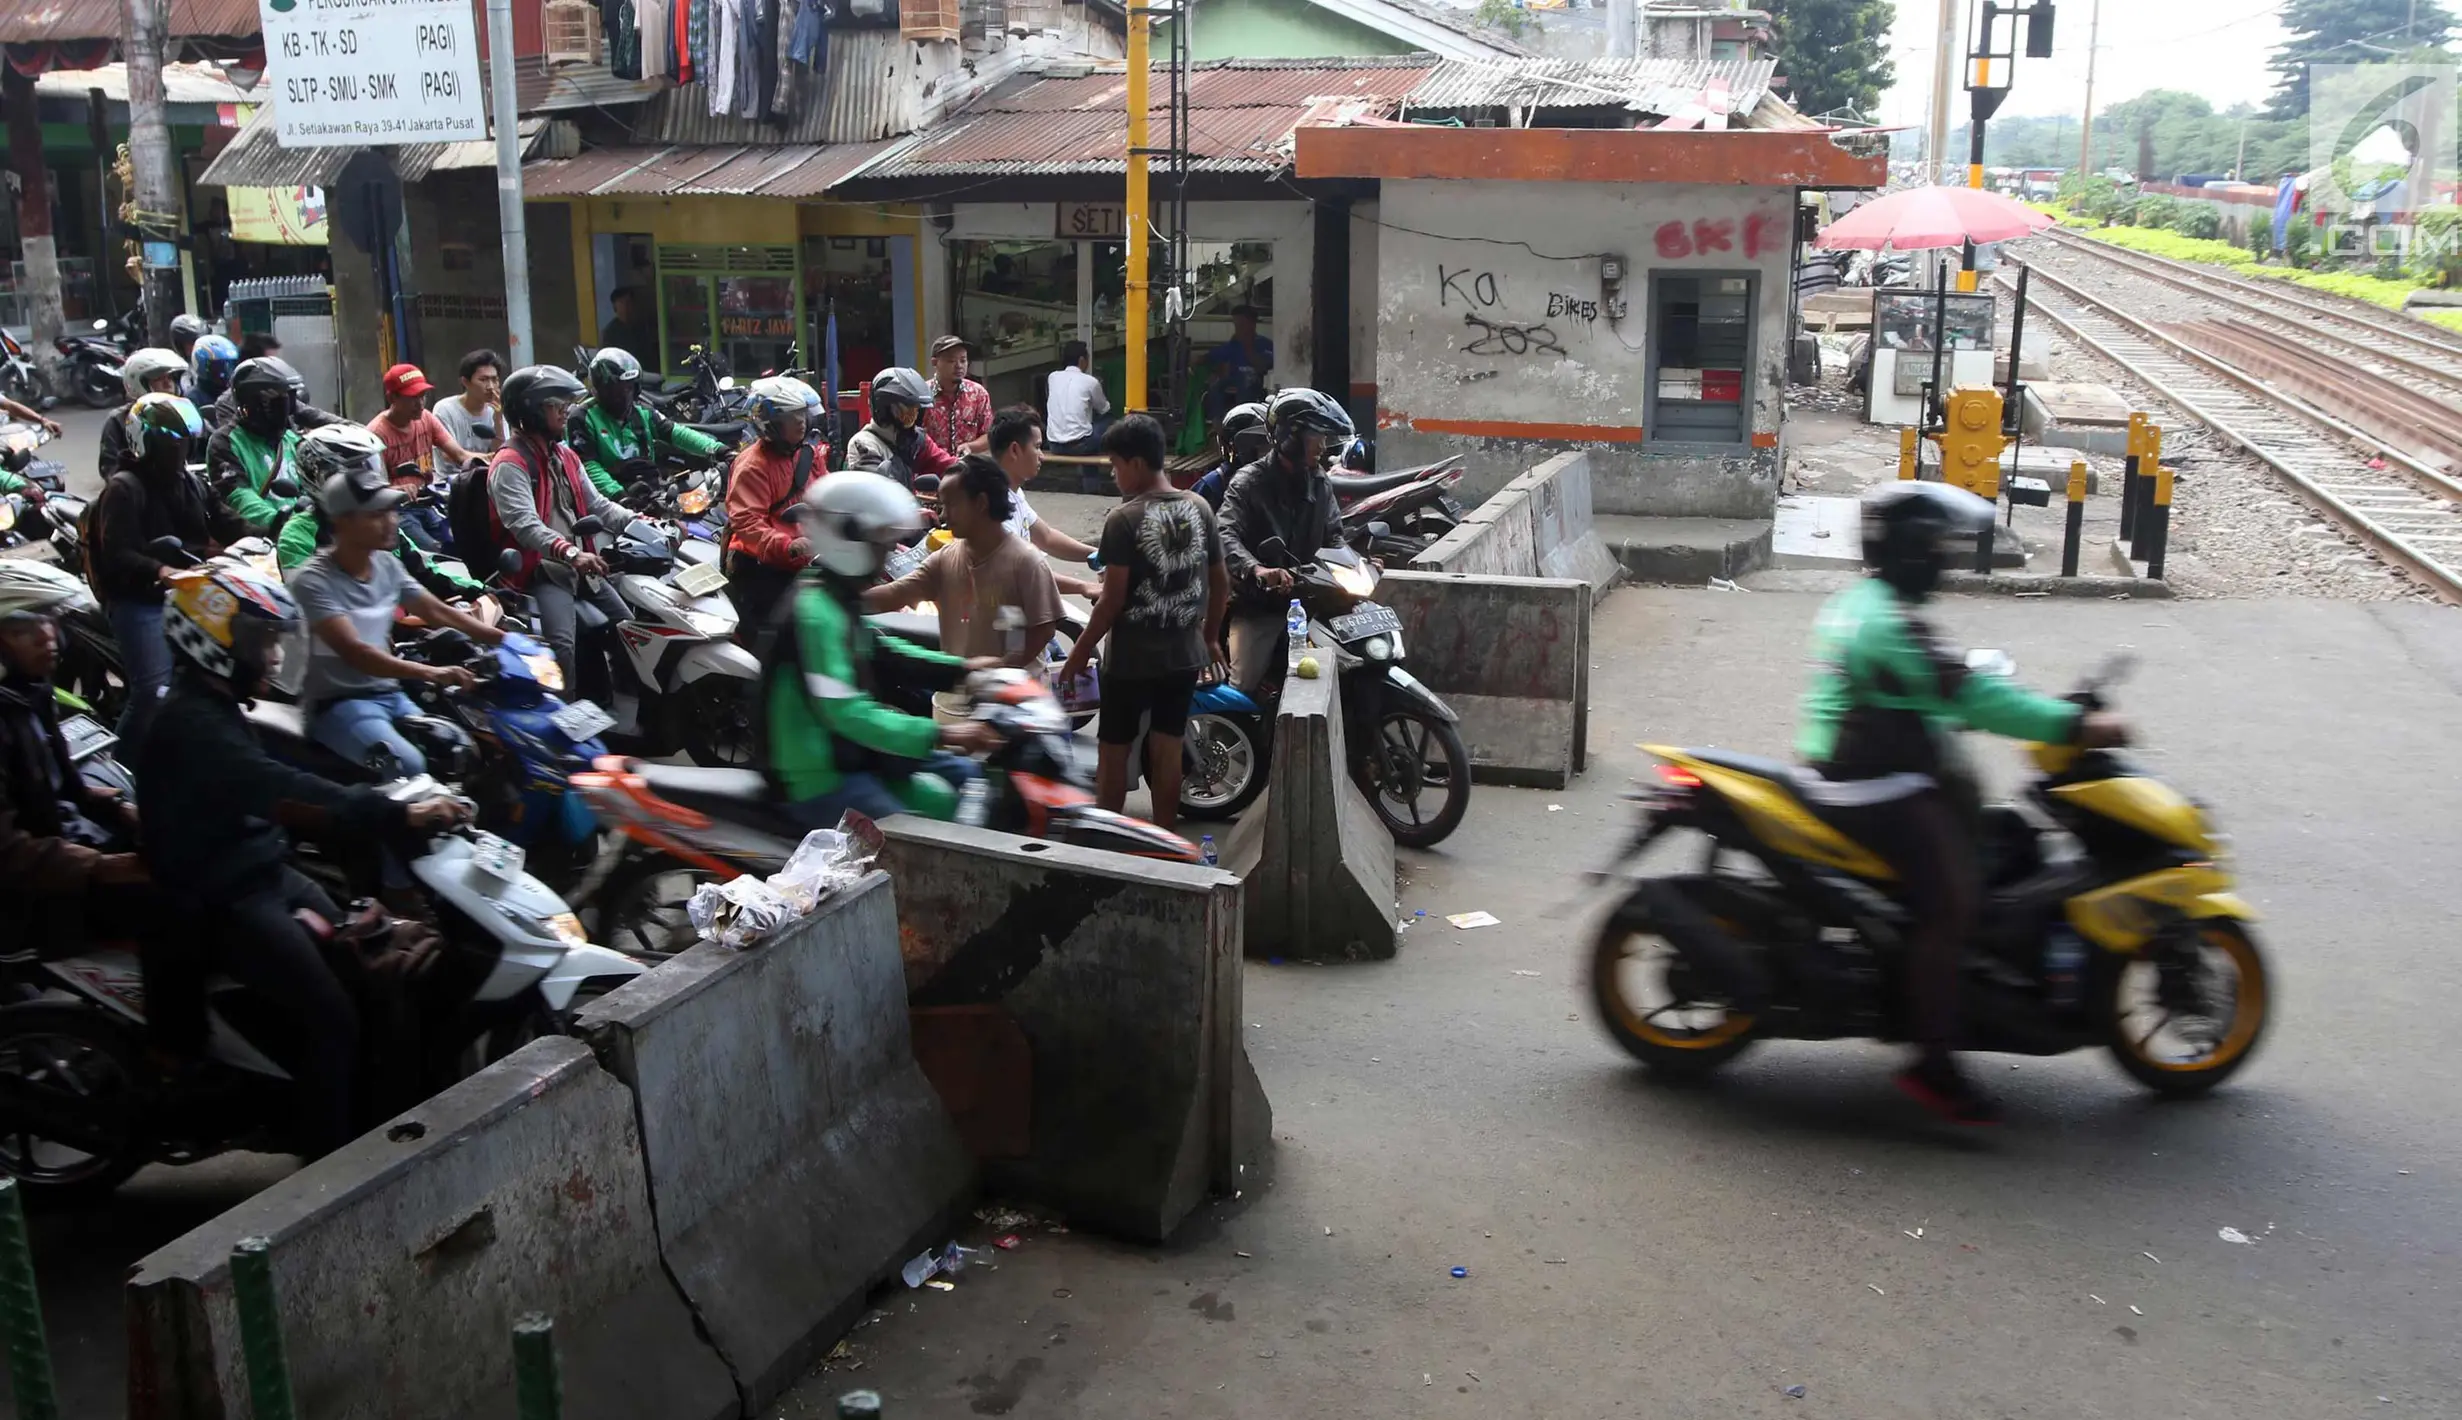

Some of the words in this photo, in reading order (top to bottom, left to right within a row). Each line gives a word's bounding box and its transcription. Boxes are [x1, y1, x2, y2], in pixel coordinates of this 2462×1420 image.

[282, 32, 301, 58] KB
[311, 31, 330, 56] TK
[339, 29, 358, 55] SD
[415, 24, 456, 58] (PAGI)
[287, 77, 318, 103] SLTP
[330, 75, 358, 102] SMU
[369, 73, 398, 99] SMK
[421, 70, 461, 104] (PAGI)
[299, 121, 352, 136] Setiakawan
[355, 120, 379, 137] Raya
[381, 119, 407, 133] 39-41
[408, 117, 443, 132] Jakarta
[446, 116, 475, 131] Pusat
[1072, 208, 1122, 233] SETI
[1348, 613, 1373, 628] 6799
[1375, 609, 1395, 621] TTC
